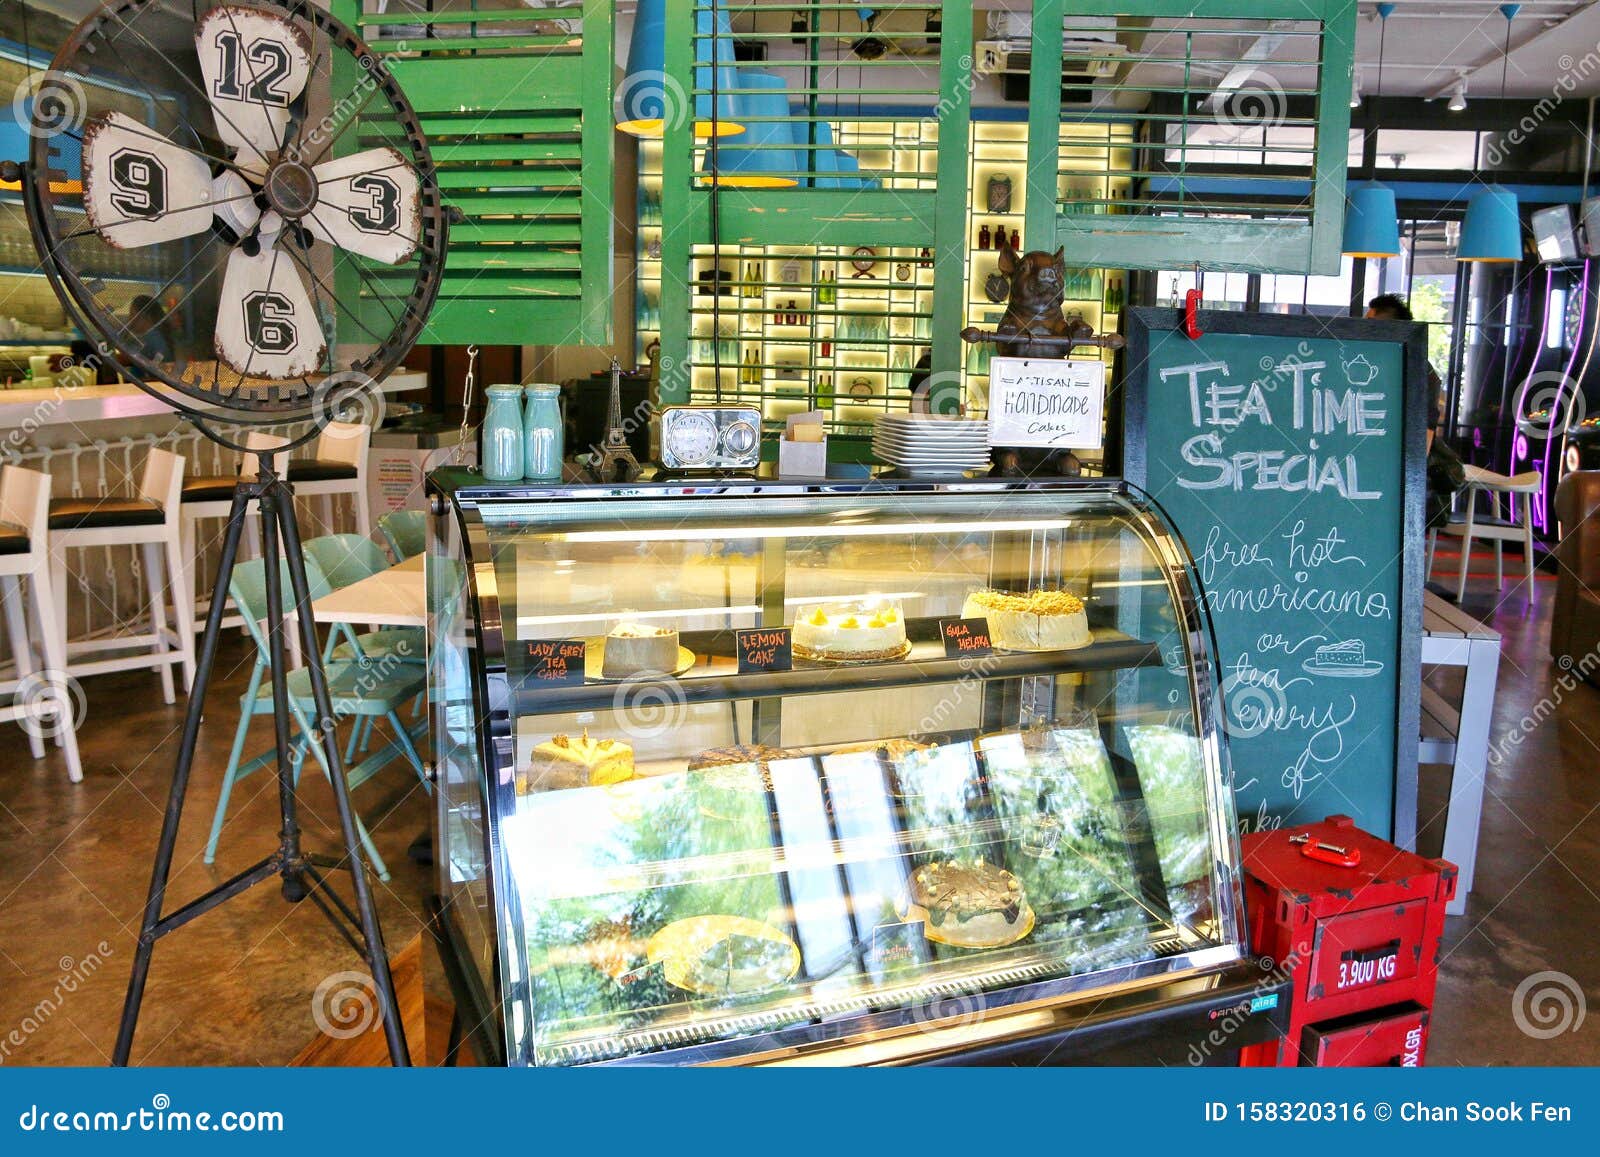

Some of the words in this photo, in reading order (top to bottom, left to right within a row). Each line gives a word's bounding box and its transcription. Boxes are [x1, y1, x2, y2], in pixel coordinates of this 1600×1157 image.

[214, 30, 291, 109] 12
[109, 147, 168, 222] 9
[349, 173, 401, 235] 3
[242, 290, 298, 354] 6
[1160, 361, 1272, 427] TEA
[1195, 526, 1273, 584] free
[1282, 520, 1366, 568] hot
[1194, 571, 1391, 620] americano
[528, 643, 554, 655] LADY
[560, 643, 585, 657] GREY
[543, 657, 567, 669] TEA
[740, 632, 786, 649] LEMON
[747, 648, 775, 667] CAKE
[1226, 653, 1314, 693] tea
[1234, 695, 1355, 762] every
[1281, 748, 1322, 799] of
[1337, 960, 1374, 988] 3.900
[1377, 954, 1396, 979] KG
